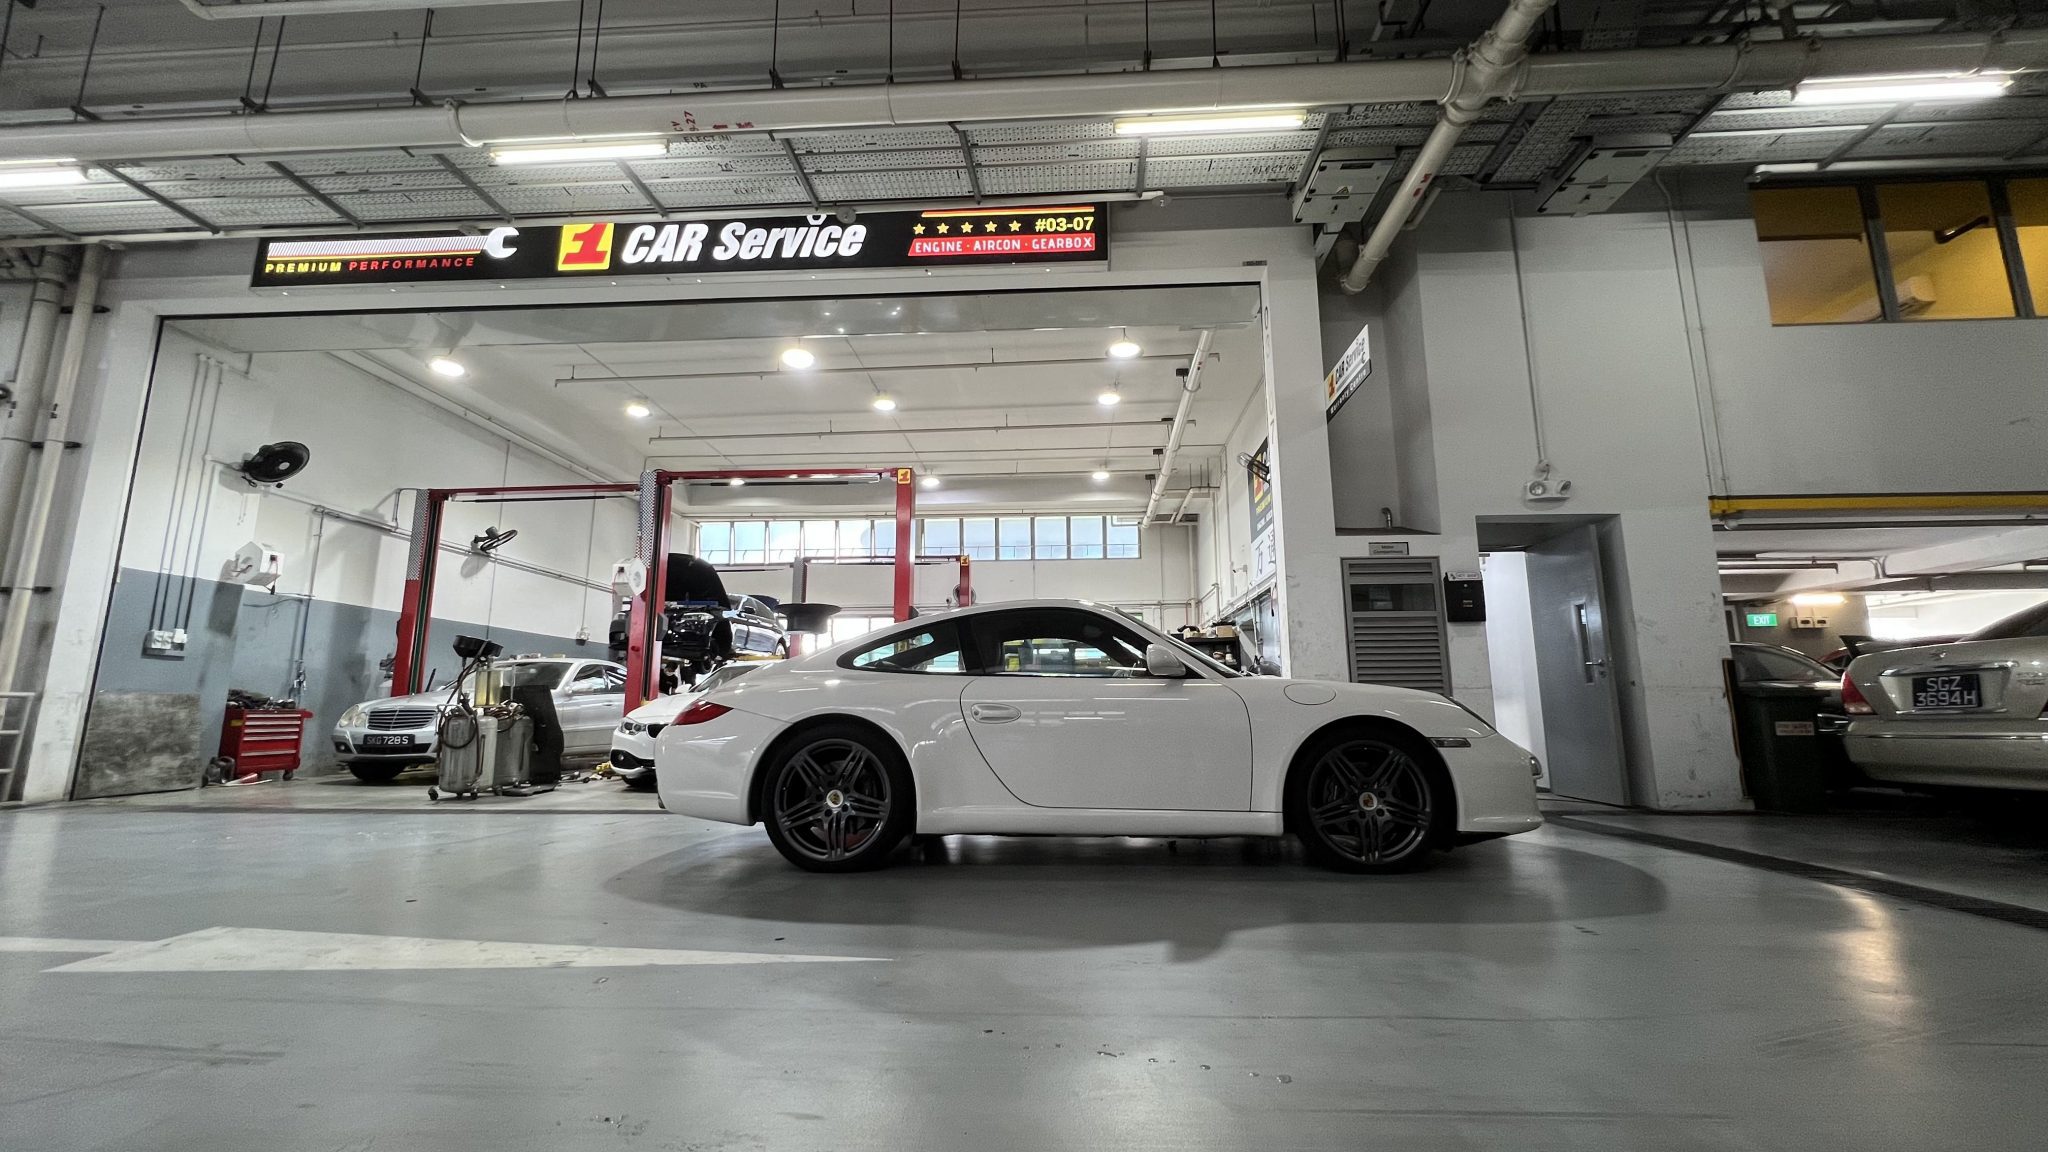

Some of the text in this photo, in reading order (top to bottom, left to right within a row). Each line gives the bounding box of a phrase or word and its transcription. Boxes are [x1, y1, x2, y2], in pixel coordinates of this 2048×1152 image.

[1035, 216, 1095, 232] #03-07
[622, 224, 709, 264] CAR
[712, 214, 867, 261] Service
[915, 236, 1093, 253] ENGINE AIRCON GEARBOX
[265, 257, 475, 273] PREMIUM PERFORMANCE
[1753, 615, 1771, 625] EXIT
[1926, 676, 1962, 691] SGZ
[1916, 690, 1976, 706] 3694H
